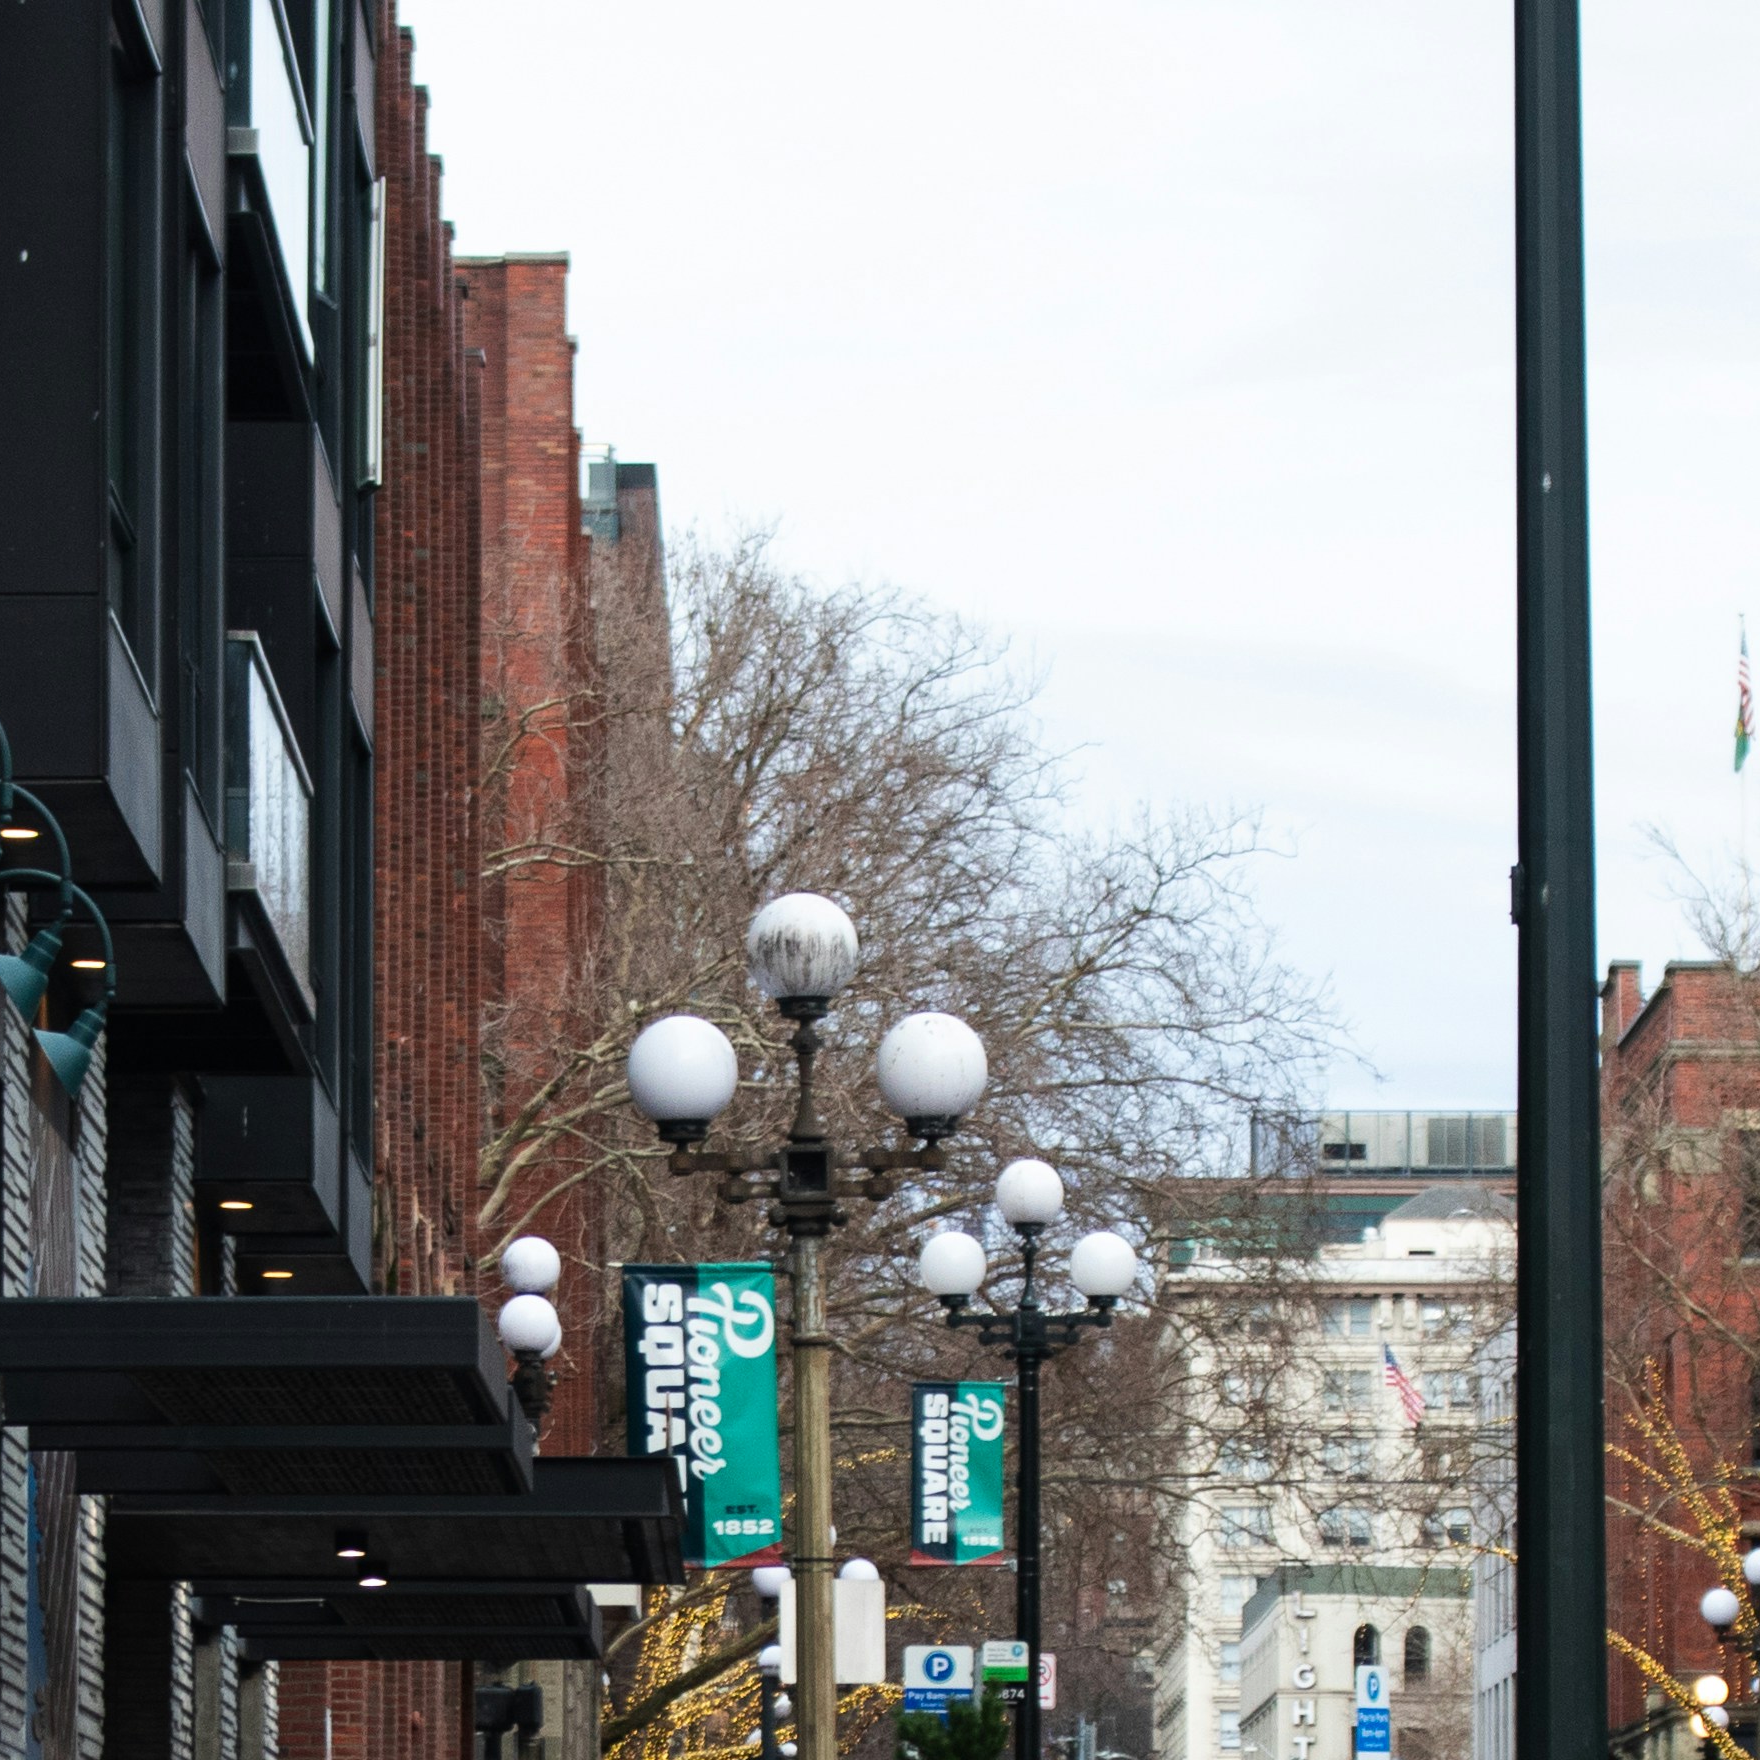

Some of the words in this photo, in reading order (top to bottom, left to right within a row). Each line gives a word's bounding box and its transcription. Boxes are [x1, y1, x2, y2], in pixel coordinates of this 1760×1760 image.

[638, 1283, 689, 1516] SQUA
[687, 1281, 775, 1482] Pioneer
[919, 1393, 948, 1544] SQUARE
[948, 1393, 1004, 1513] Pioneer
[713, 1519, 775, 1536] 1852
[961, 1536, 1000, 1546] 1852
